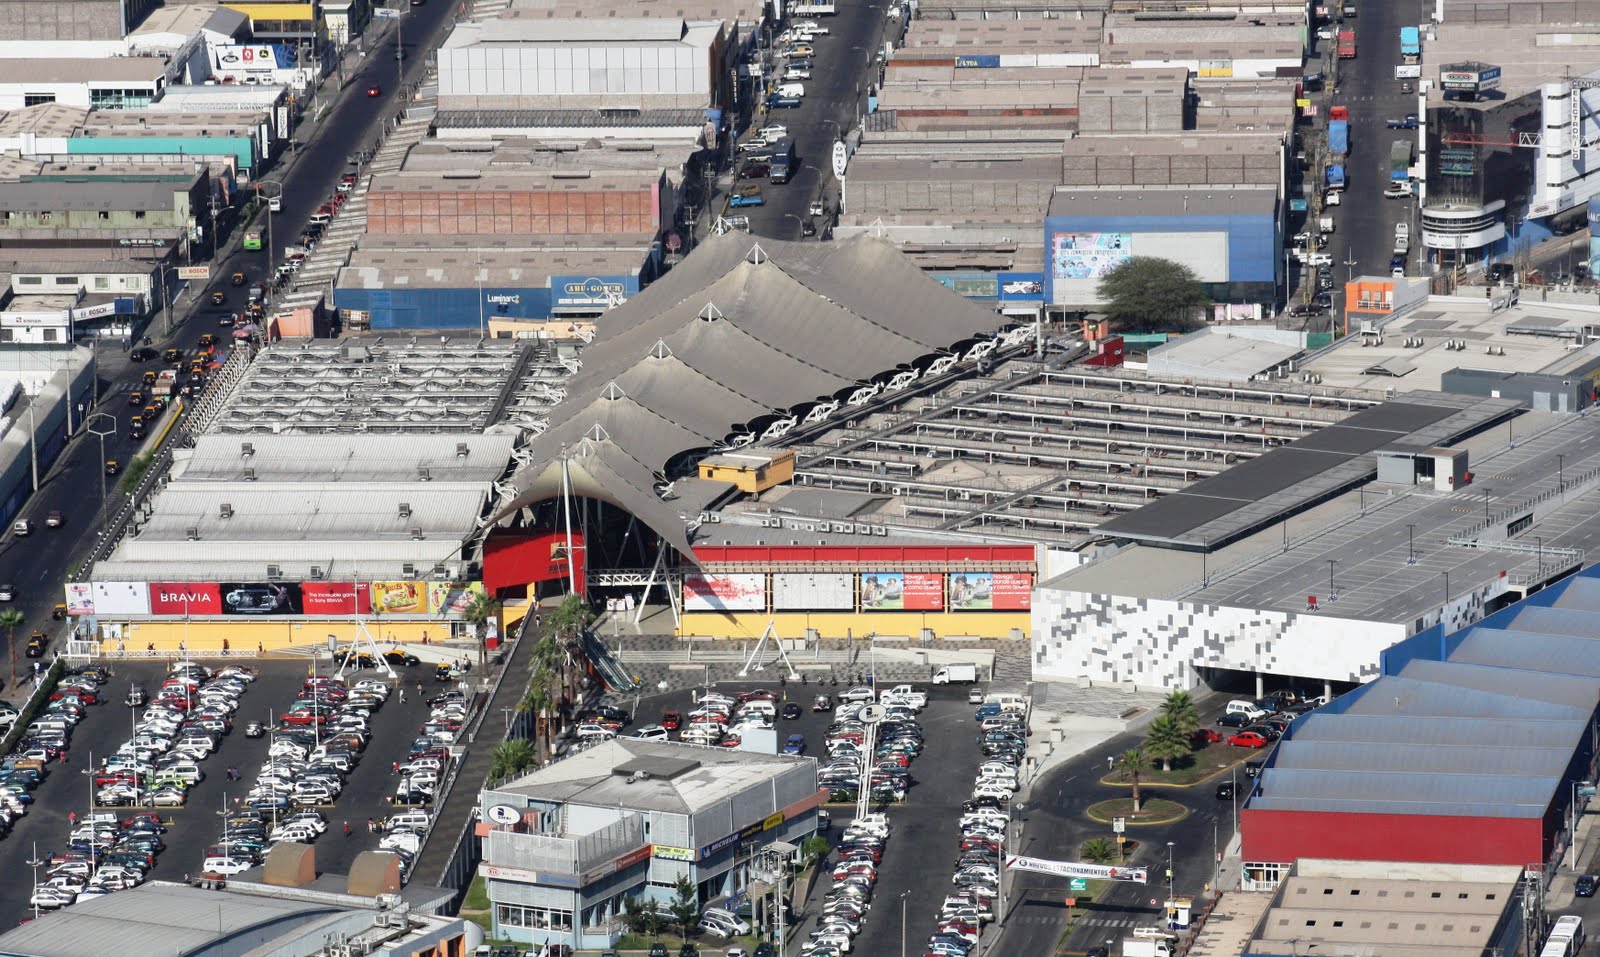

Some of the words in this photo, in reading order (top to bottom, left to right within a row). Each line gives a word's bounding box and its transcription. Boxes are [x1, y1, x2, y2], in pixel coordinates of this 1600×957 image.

[1482, 70, 1498, 79] SONY
[1303, 106, 1317, 116] TELAS
[487, 293, 515, 303] Luminarc
[88, 307, 107, 316] BOSCH
[160, 593, 211, 602] BRAVIA
[711, 833, 740, 851] MICHELIN
[1053, 864, 1108, 877] ESTACIONAMIENTOS
